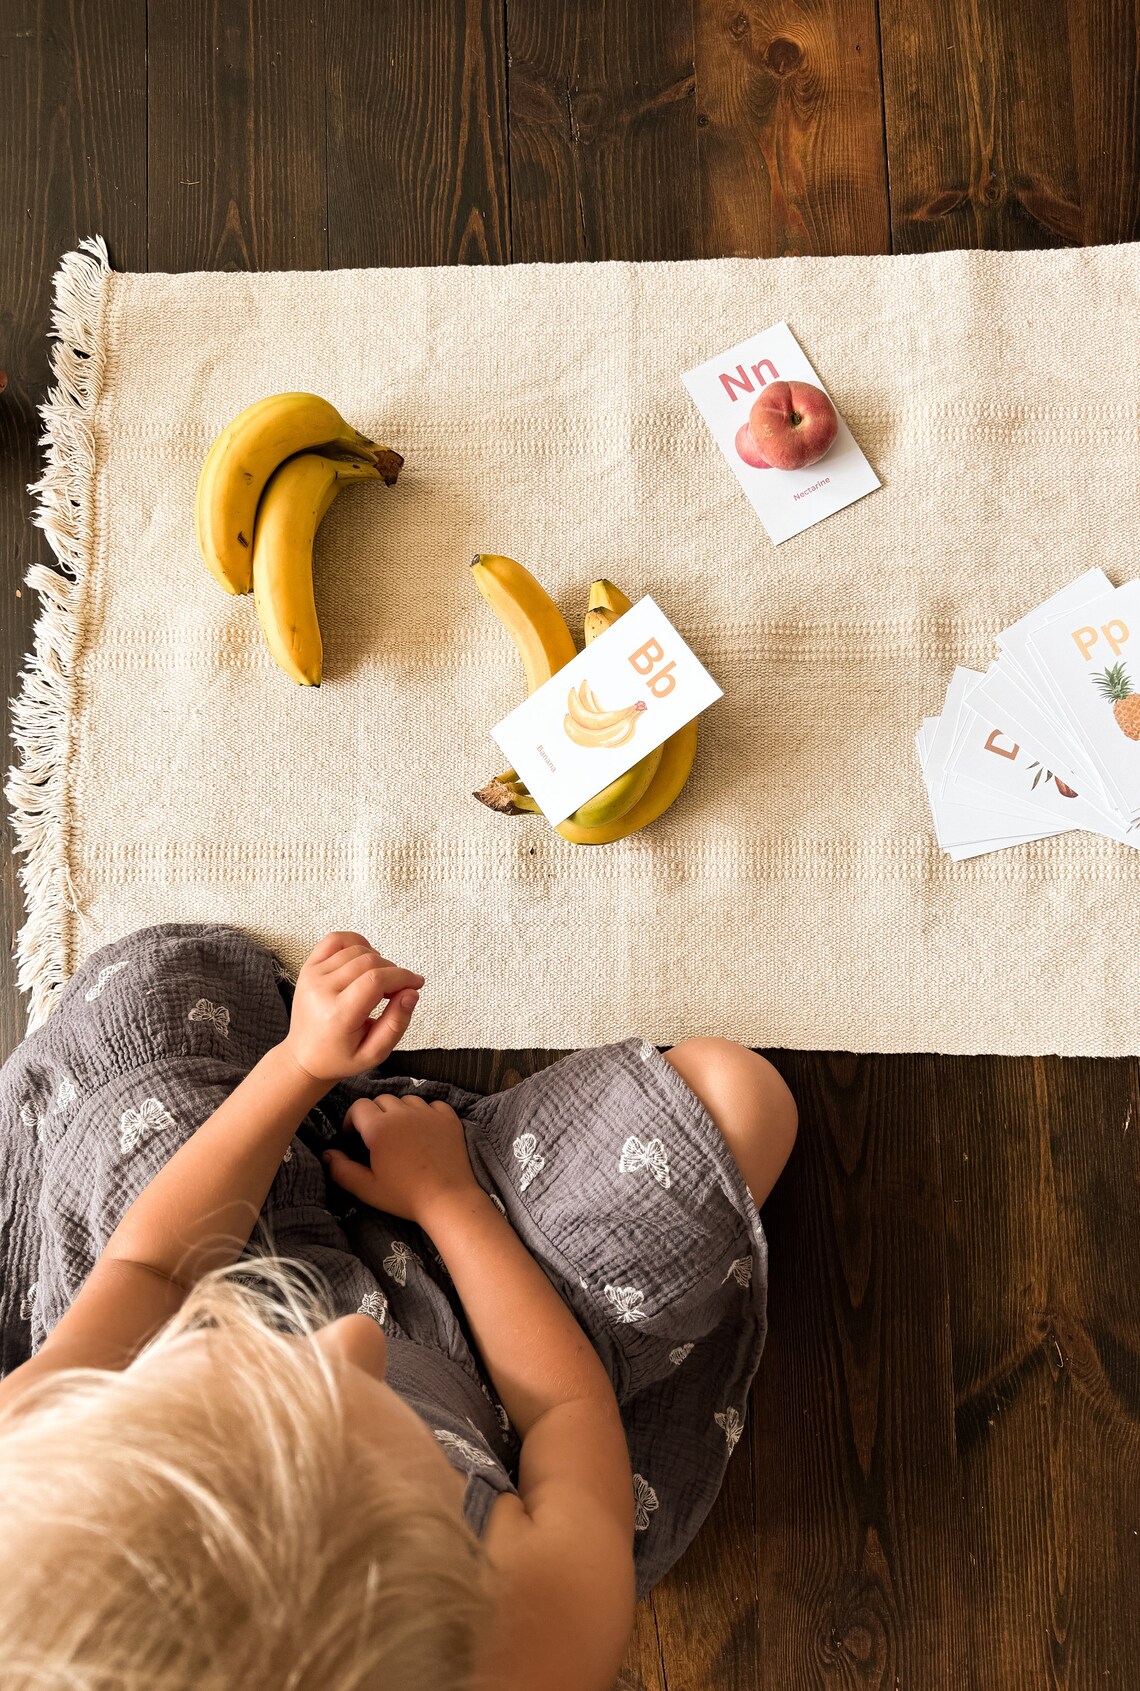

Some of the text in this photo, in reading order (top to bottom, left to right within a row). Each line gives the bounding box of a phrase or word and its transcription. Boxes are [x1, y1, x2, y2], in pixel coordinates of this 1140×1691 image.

[718, 359, 780, 402] Nn
[794, 477, 830, 501] Nectarine
[1072, 619, 1130, 661] Pp
[628, 637, 677, 698] Bb
[536, 745, 556, 773] Banana
